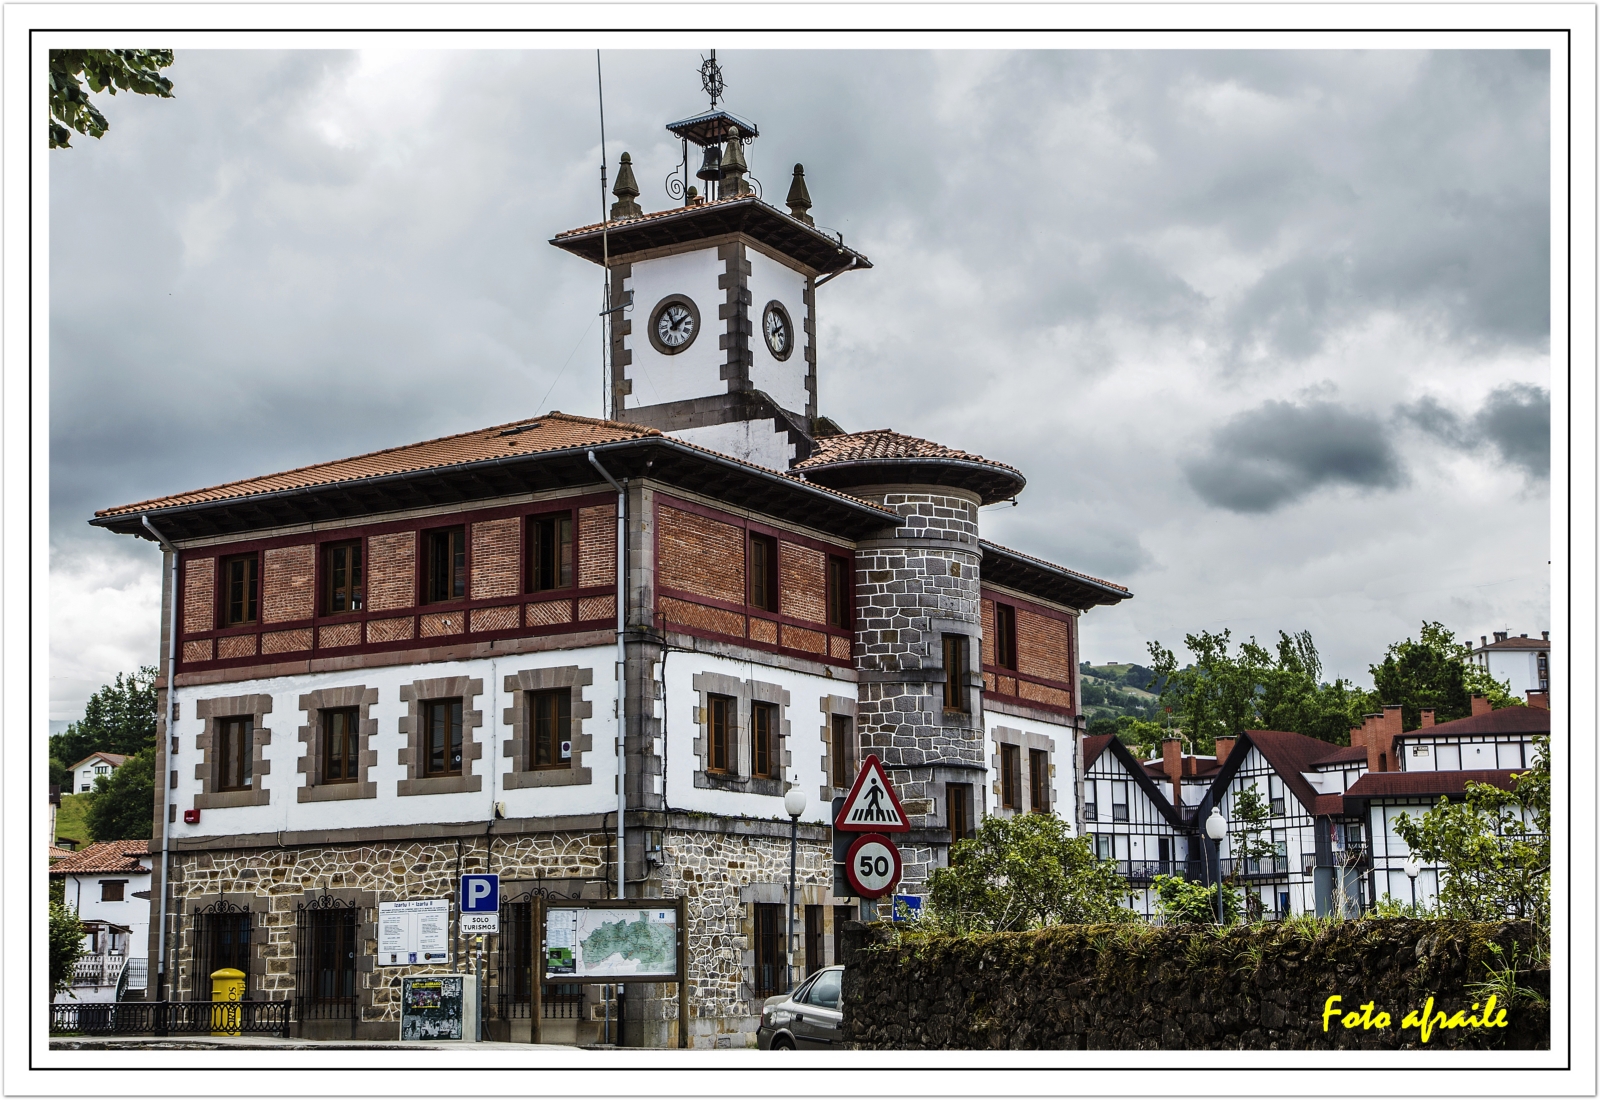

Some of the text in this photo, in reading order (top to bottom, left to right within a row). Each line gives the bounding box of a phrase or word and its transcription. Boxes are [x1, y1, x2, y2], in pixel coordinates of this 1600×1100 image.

[860, 856, 889, 877] 50
[468, 878, 491, 909] P
[226, 986, 237, 1036] CRROS
